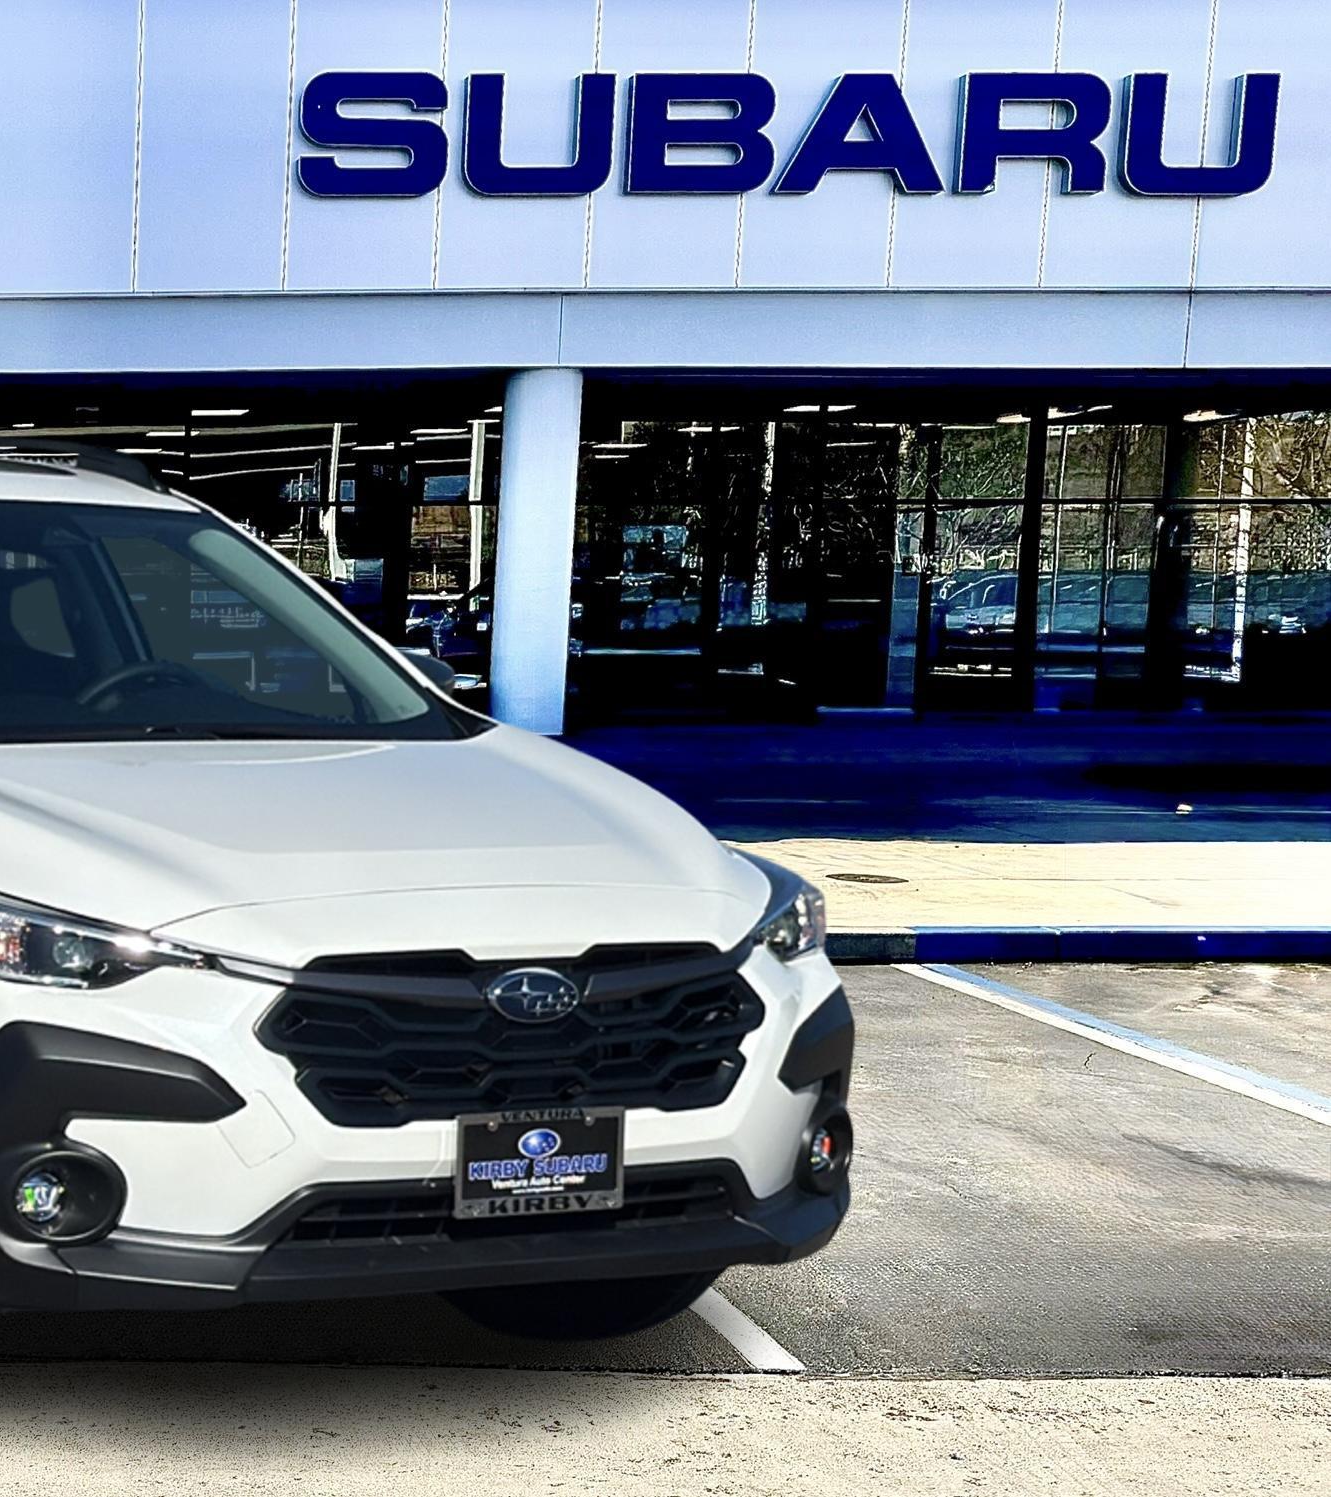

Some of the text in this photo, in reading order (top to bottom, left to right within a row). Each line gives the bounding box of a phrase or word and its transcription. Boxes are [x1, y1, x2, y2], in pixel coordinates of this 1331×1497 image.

[296, 71, 1282, 197] SUBARU
[501, 1107, 585, 1122] VENTURA
[468, 1153, 608, 1181] KIRBY SUBARU
[491, 1174, 586, 1190] Ventura Auto Center
[488, 1194, 593, 1214] KIRBY
